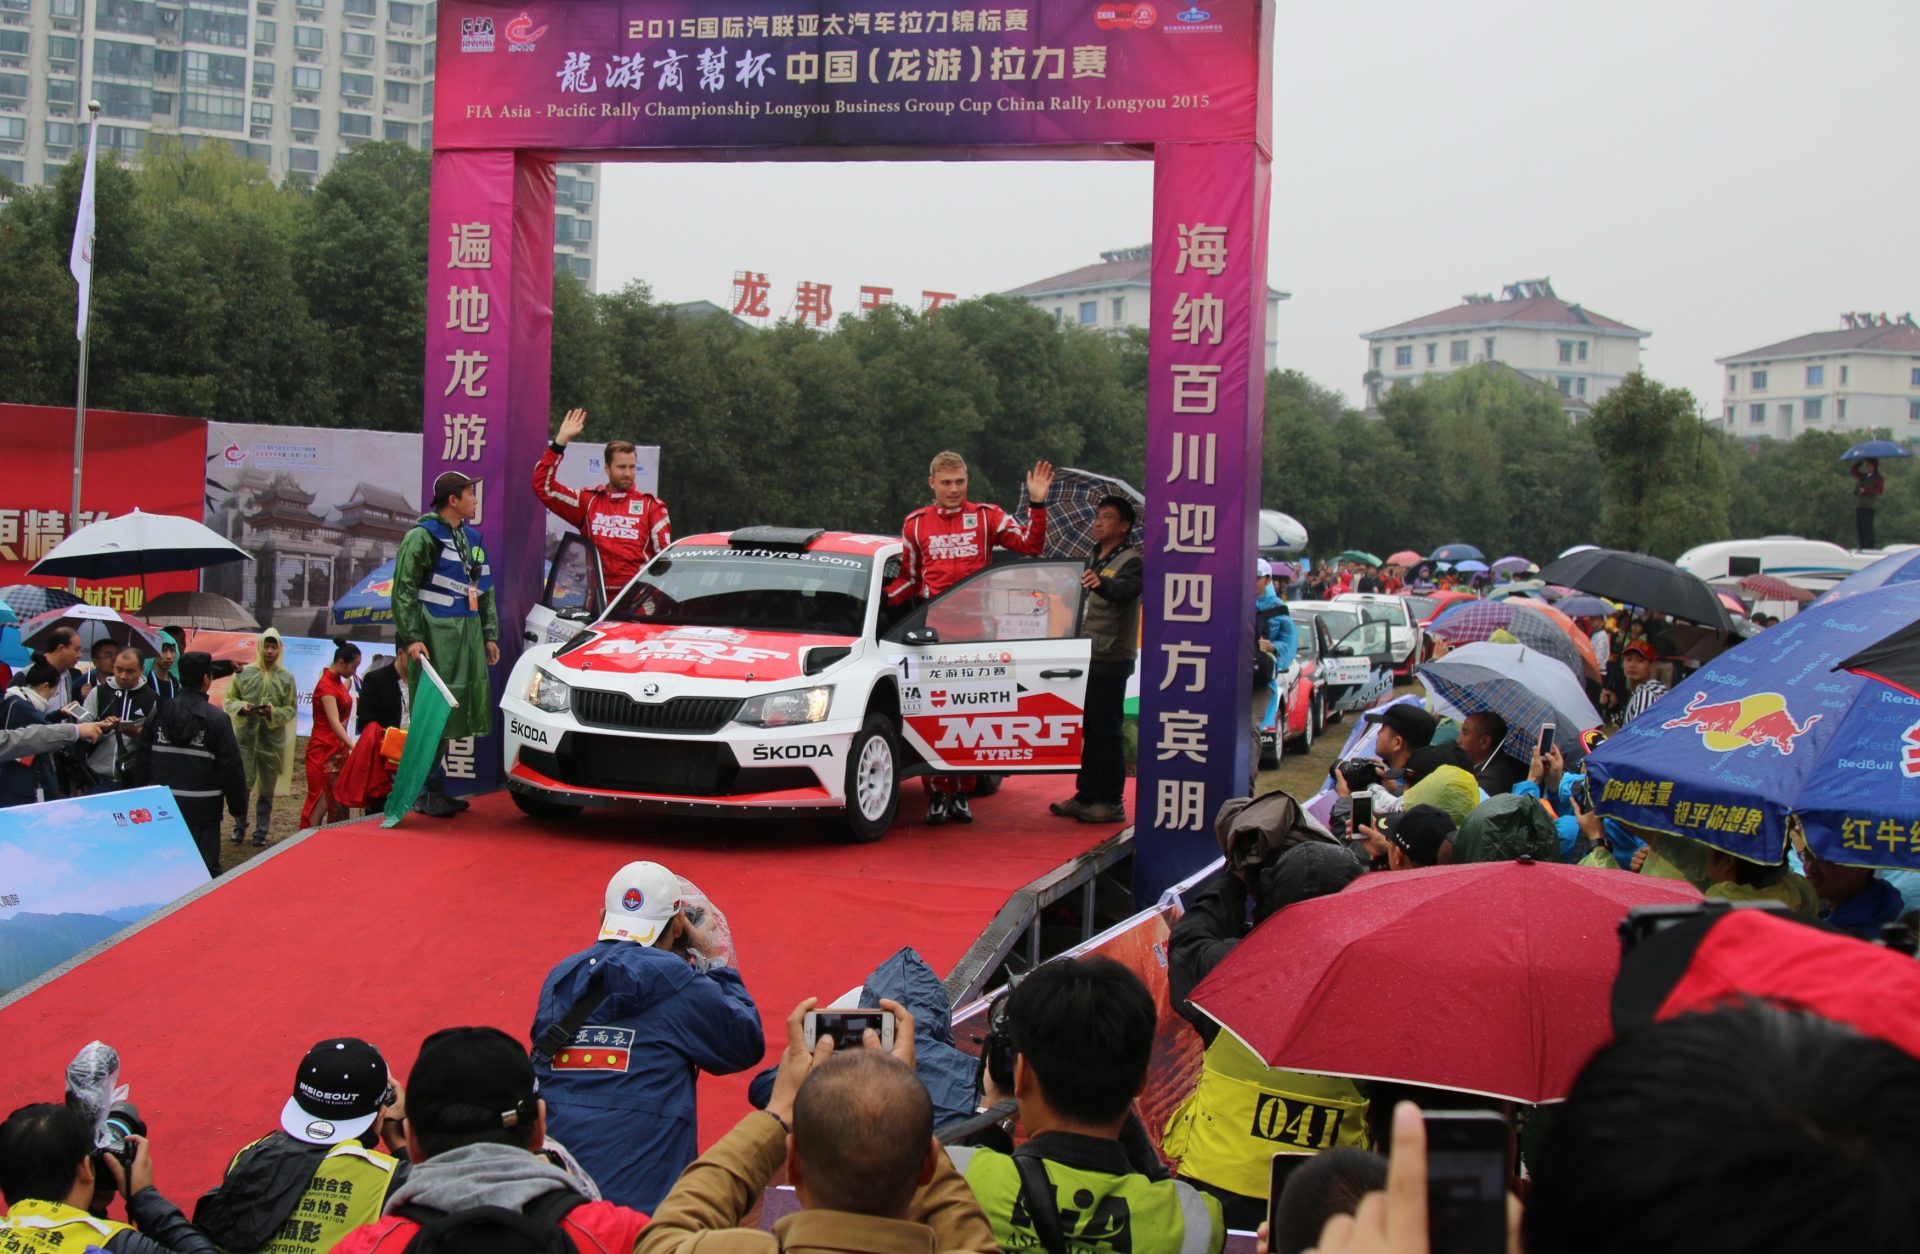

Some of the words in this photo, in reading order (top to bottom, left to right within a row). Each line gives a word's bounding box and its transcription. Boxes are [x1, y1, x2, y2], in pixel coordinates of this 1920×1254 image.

[628, 8, 1028, 39] 2015国际汽联亚太汽车拉力锦标赛
[466, 105, 494, 119] FIA
[499, 104, 532, 118] Asia
[546, 103, 597, 118] Pacific
[602, 102, 641, 120] Rally
[644, 101, 761, 121] Championship
[765, 101, 831, 119] Longyou
[834, 99, 900, 115] Business
[904, 98, 956, 116] Group
[959, 98, 993, 115] Cup
[997, 96, 1045, 112] China
[1049, 95, 1090, 115] Rally
[1095, 95, 1167, 114] Longyou
[1171, 94, 1211, 109] 2015
[592, 512, 640, 529] MRF
[1153, 223, 1229, 832] 海纳百川迎四方宾朋
[591, 524, 640, 540] TYRES
[928, 531, 978, 548] MRF
[669, 547, 863, 569] www.mrftyres.com
[928, 544, 979, 560] TYRES
[583, 639, 791, 664] MRF
[637, 652, 716, 665] TYRES
[898, 656, 910, 680] 1
[1703, 670, 1750, 688] RedBull
[934, 714, 1083, 750] MRF
[974, 748, 1034, 762] TYRES
[1838, 758, 1894, 771] RedBull
[1600, 778, 1675, 807] 你的能量
[1674, 800, 1765, 836] 超乎你想象
[574, 1029, 628, 1046] 亚雨衣
[300, 1082, 360, 1101] INSIDEOUT
[1258, 1097, 1338, 1149] 041
[294, 1198, 348, 1218] 动协会
